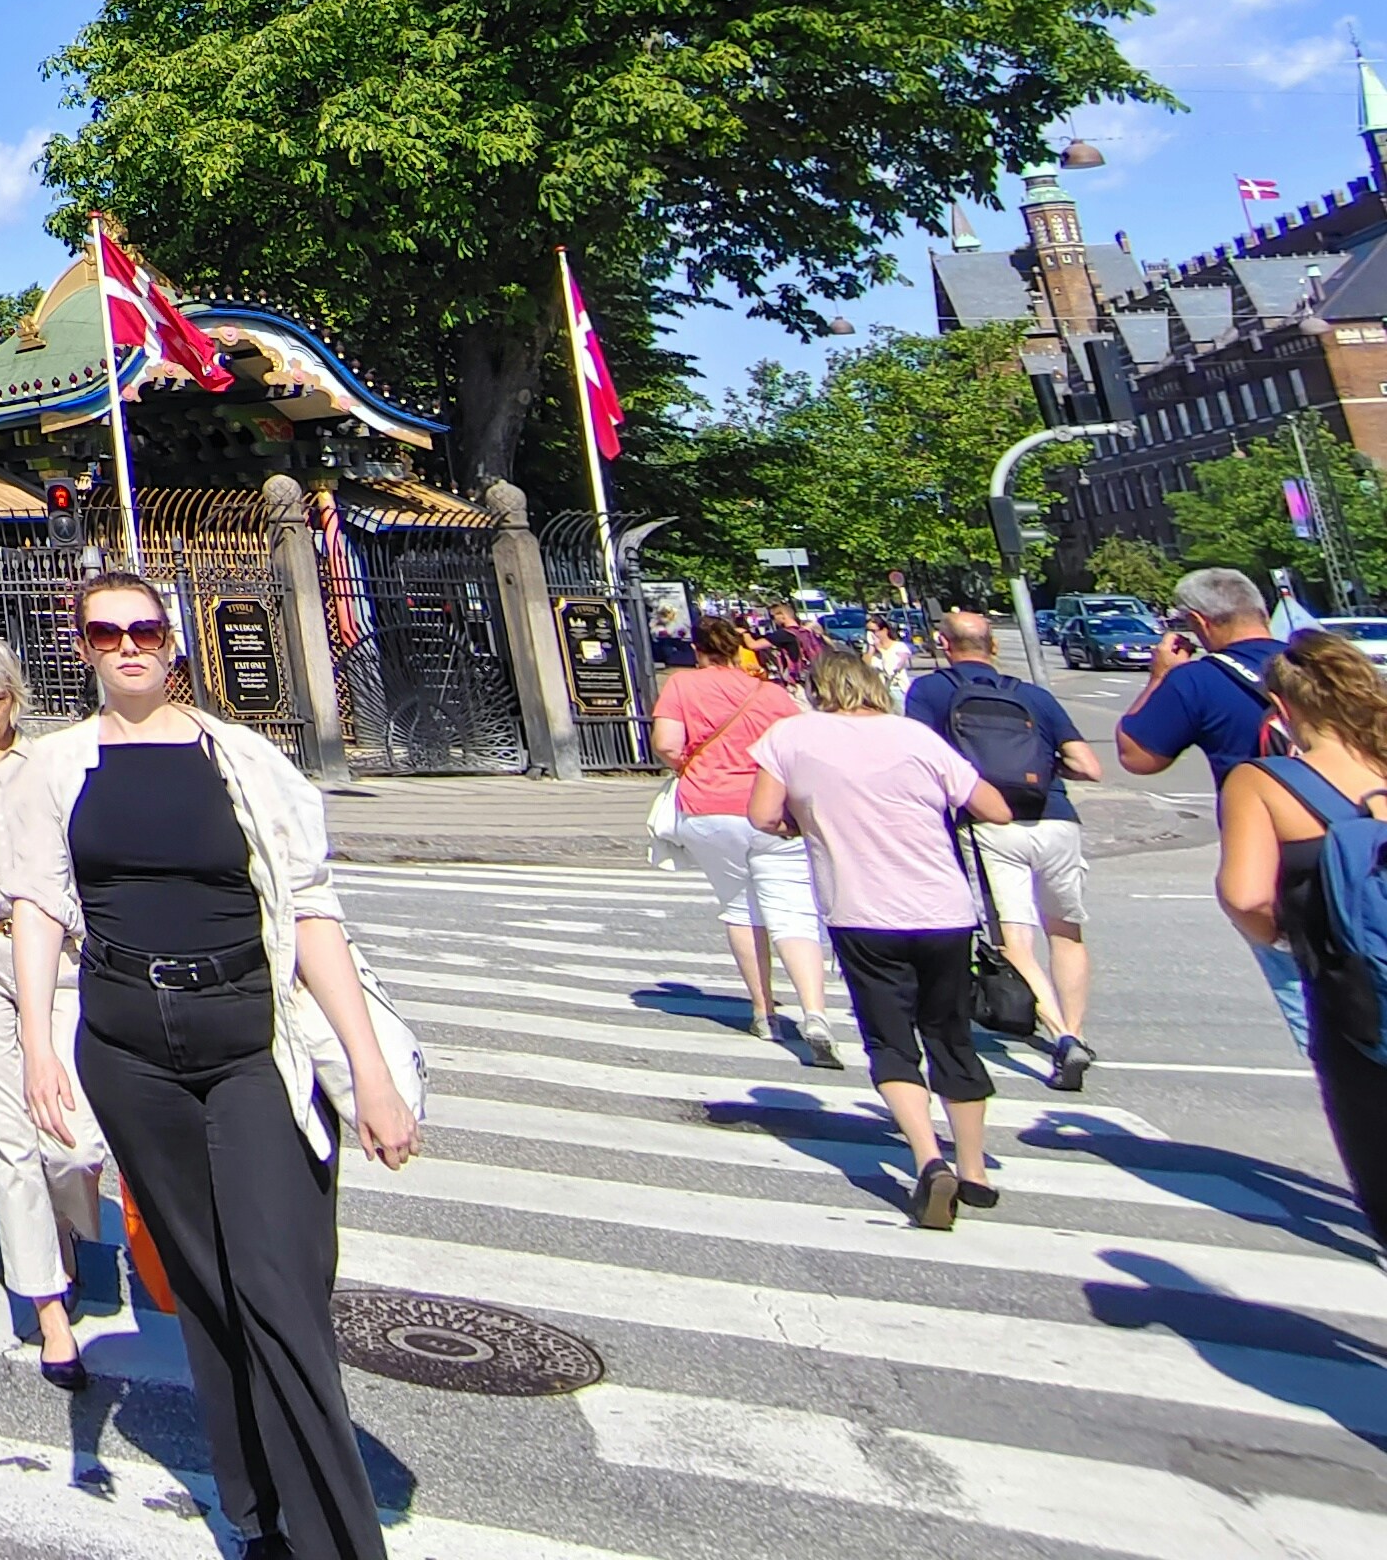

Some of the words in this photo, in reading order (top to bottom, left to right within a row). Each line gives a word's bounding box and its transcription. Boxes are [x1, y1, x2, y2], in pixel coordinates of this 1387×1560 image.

[225, 603, 254, 614] TIVOLI
[572, 605, 601, 615] TIVOLI
[234, 661, 250, 670] EXIT
[250, 661, 267, 670] ONLY
